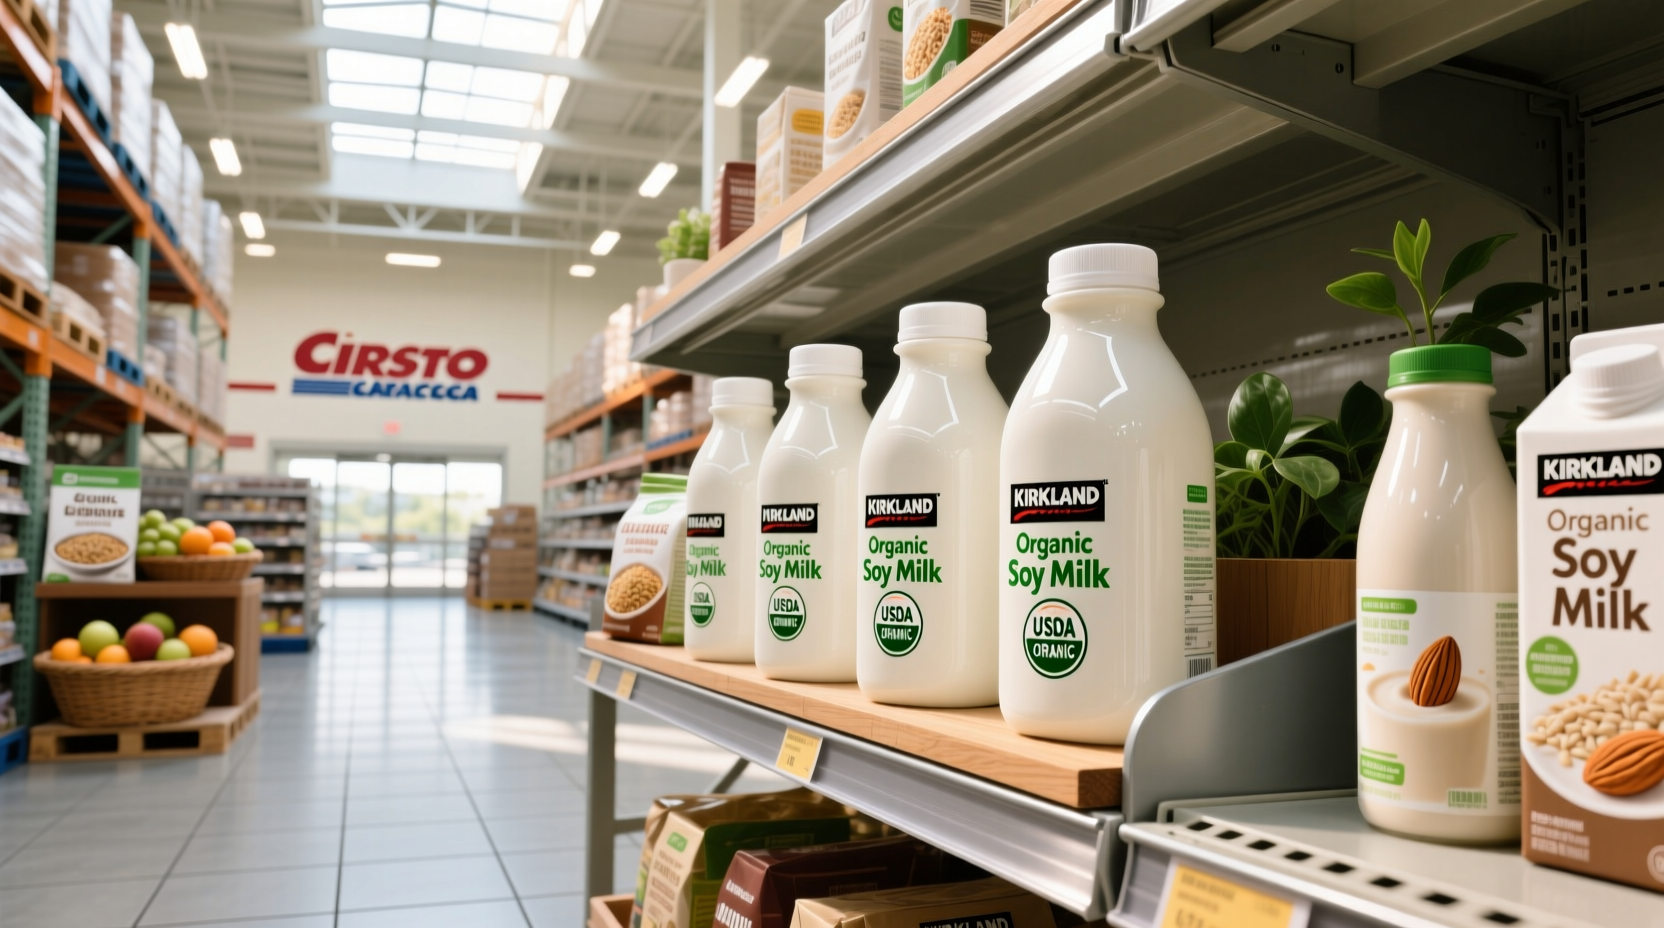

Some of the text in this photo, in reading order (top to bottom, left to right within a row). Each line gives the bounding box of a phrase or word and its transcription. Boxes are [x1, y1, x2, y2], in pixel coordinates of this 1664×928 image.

[1543, 453, 1663, 481] KIRKLAND
[868, 498, 933, 516] KIRKLAND
[1014, 486, 1100, 508] KIRKLAND
[1547, 507, 1650, 538] Organic
[764, 540, 811, 559] Organic
[868, 535, 928, 559] Organic
[1016, 530, 1093, 560] Organic
[700, 559, 726, 576] Milk
[759, 559, 822, 584] Soy Milk
[863, 558, 942, 589] Soy Milk
[1552, 537, 1638, 588] Soy
[1008, 559, 1110, 595] Soy Milk
[881, 606, 913, 623] USDA
[1552, 587, 1652, 632] Milk
[1033, 616, 1076, 638] USDA
